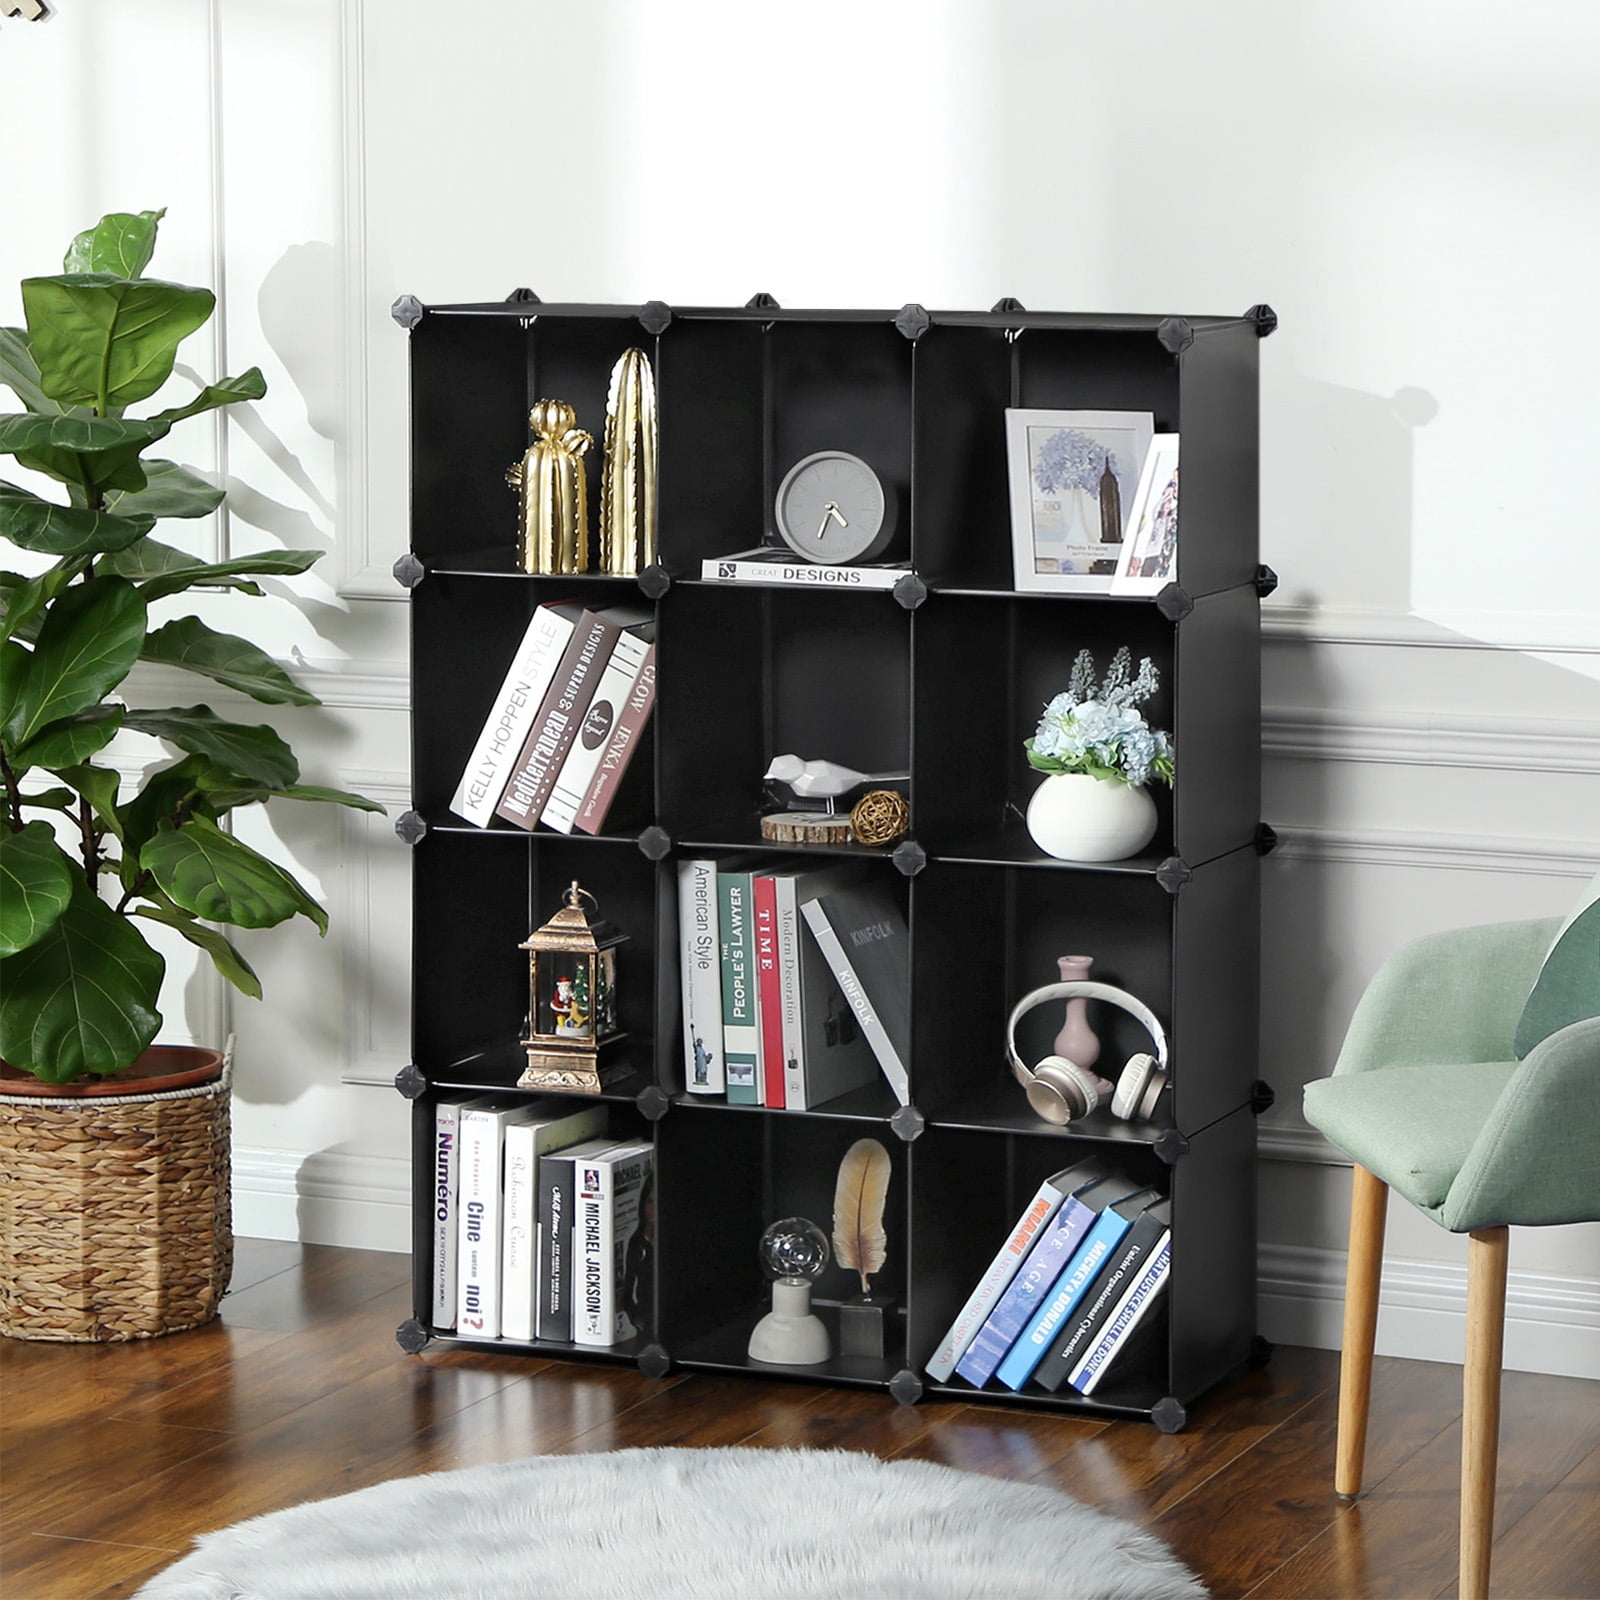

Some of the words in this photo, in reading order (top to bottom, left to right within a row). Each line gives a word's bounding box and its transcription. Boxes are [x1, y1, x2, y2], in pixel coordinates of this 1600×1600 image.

[751, 567, 777, 577] GREAT
[783, 567, 861, 583] DESIGNS
[465, 755, 497, 810] KELLY
[490, 681, 532, 755] HOPPEN
[524, 622, 557, 679] STYLE
[503, 710, 570, 818] Mediterranean
[563, 663, 587, 700] SUPERB
[580, 623, 606, 662] DESIGNS
[694, 866, 713, 932] American
[730, 887, 743, 946] LAWYER
[694, 936, 713, 970] Style
[721, 943, 729, 960] THE
[759, 909, 774, 970] TIME
[782, 909, 794, 957] Modern
[849, 920, 894, 948] KINFOLK
[732, 949, 747, 1019] PEOPLE'S
[784, 958, 796, 1024] Decoration
[838, 969, 875, 1027] KINFOLK
[437, 1132, 453, 1221] Numéro
[511, 1156, 526, 1222] Robinson
[466, 1201, 485, 1243] Cine
[510, 1225, 526, 1269] Crusoe
[585, 1203, 600, 1254] MICHAEL
[1008, 1197, 1051, 1256] MIAMI
[1051, 1219, 1076, 1250] ICE
[585, 1257, 600, 1314] JACKSON
[1022, 1258, 1048, 1293] AGE
[1072, 1240, 1108, 1290] MICKEY
[1092, 1269, 1124, 1323] Organizational
[1129, 1271, 1160, 1311] JUSTICE
[1031, 1294, 1072, 1345] DONALD
[1062, 1319, 1093, 1359] Cybernetics
[1102, 1336, 1116, 1353] BE
[1109, 1304, 1135, 1342] SHALL
[1085, 1346, 1109, 1376] DONE
